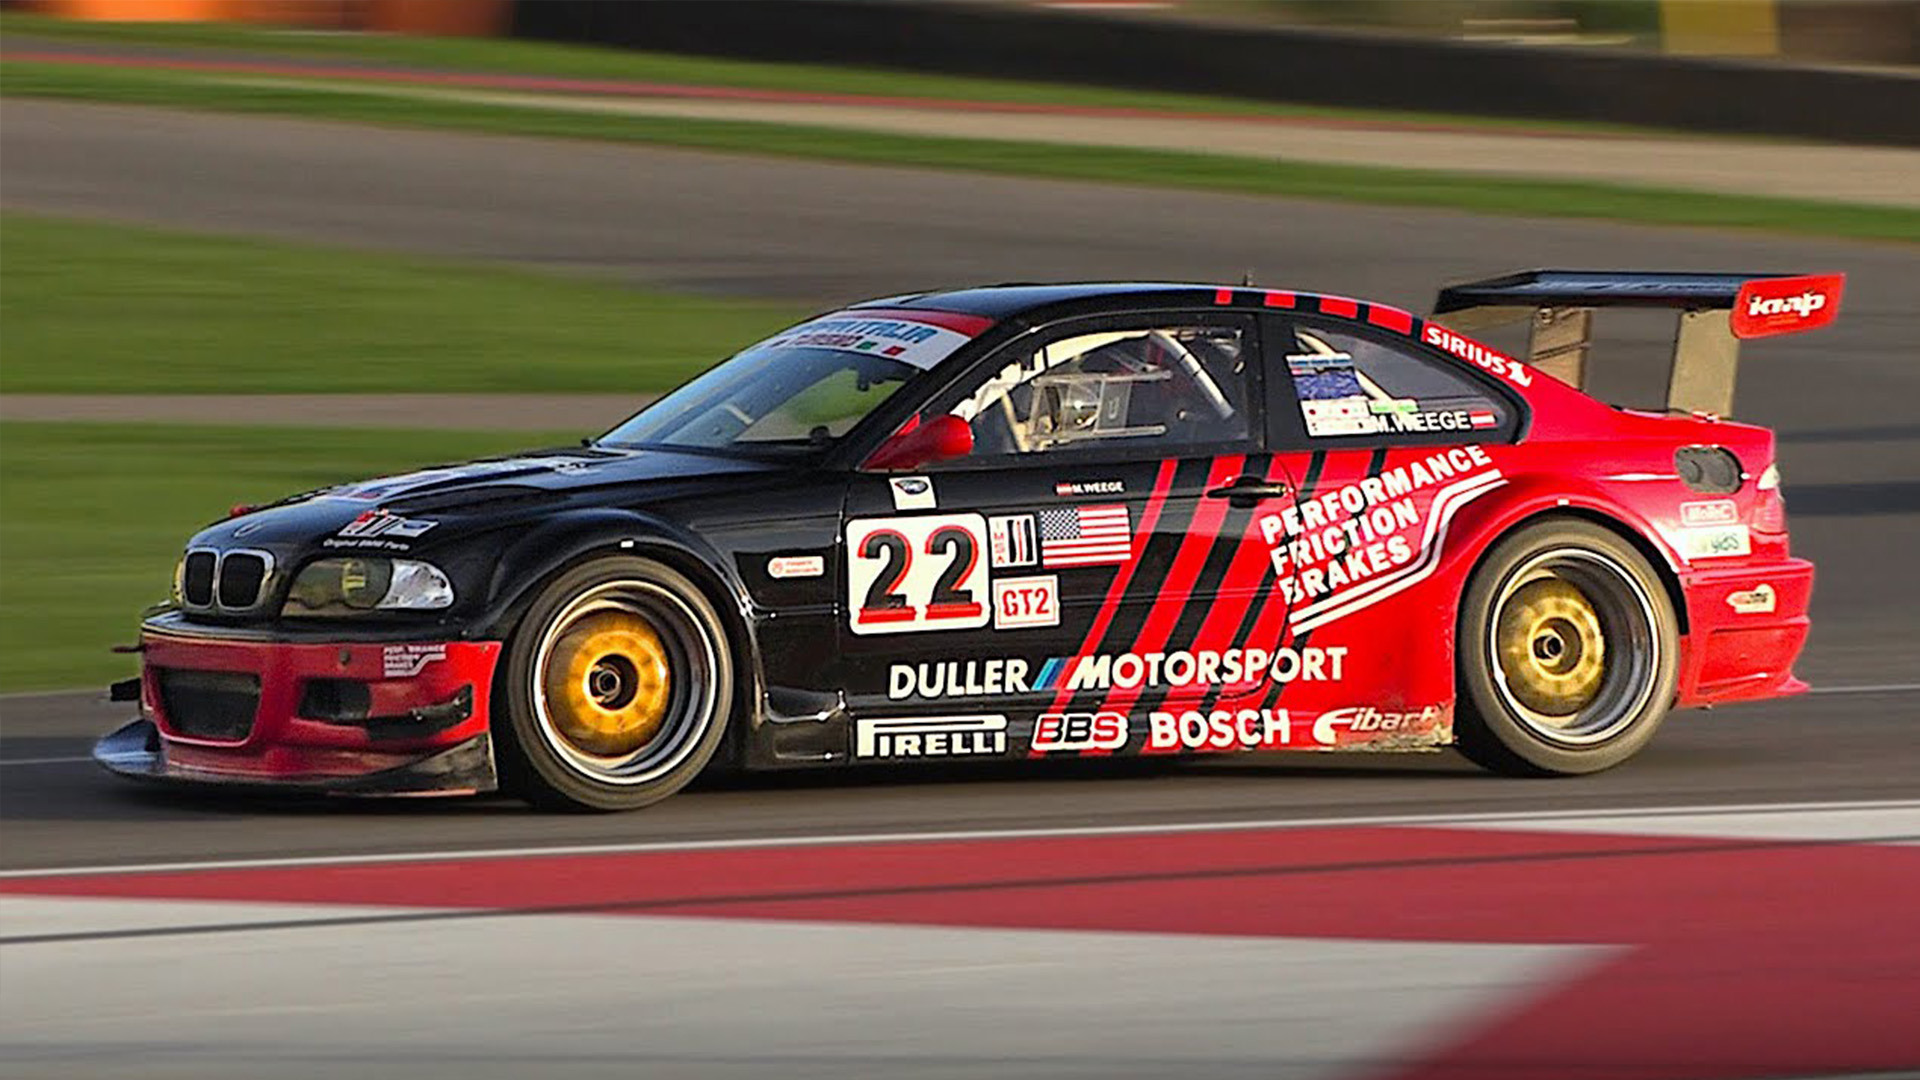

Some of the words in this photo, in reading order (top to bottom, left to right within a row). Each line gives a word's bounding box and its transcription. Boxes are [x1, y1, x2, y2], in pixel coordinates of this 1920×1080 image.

[1427, 328, 1507, 374] SIRIUS
[1259, 445, 1492, 545] PERFORMANCE
[1270, 499, 1420, 576] FRICTION
[858, 525, 982, 624] 22
[1277, 536, 1413, 605] BRAKES
[1002, 587, 1050, 617] GT2
[889, 658, 1031, 699] DULLER
[1066, 647, 1348, 690] MOTORSPORT
[857, 714, 1007, 757] PIRELLI
[1033, 714, 1123, 746] BBS
[1149, 708, 1291, 747] BOSCH
